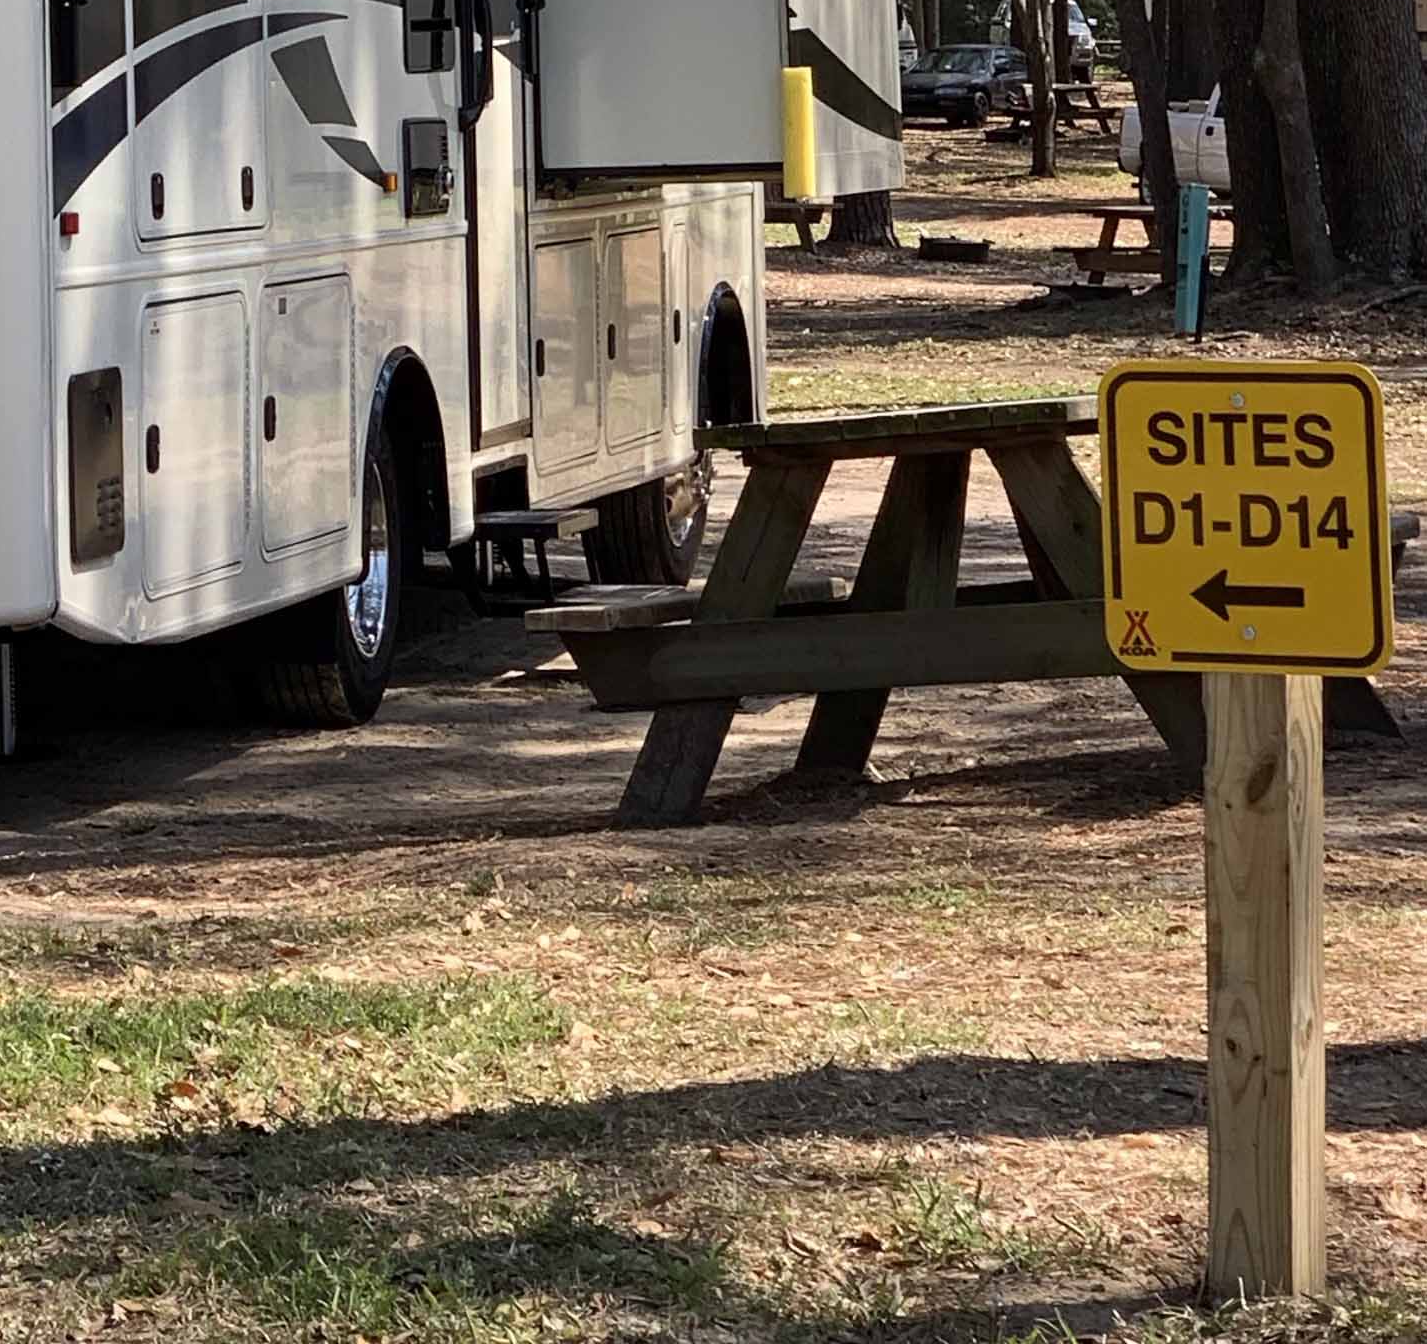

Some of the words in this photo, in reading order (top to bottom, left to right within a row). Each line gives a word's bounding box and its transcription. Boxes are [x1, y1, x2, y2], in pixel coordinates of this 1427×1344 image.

[1147, 411, 1335, 468] SITES
[1133, 491, 1354, 550] D1-D14
[1119, 647, 1157, 657] KOA
